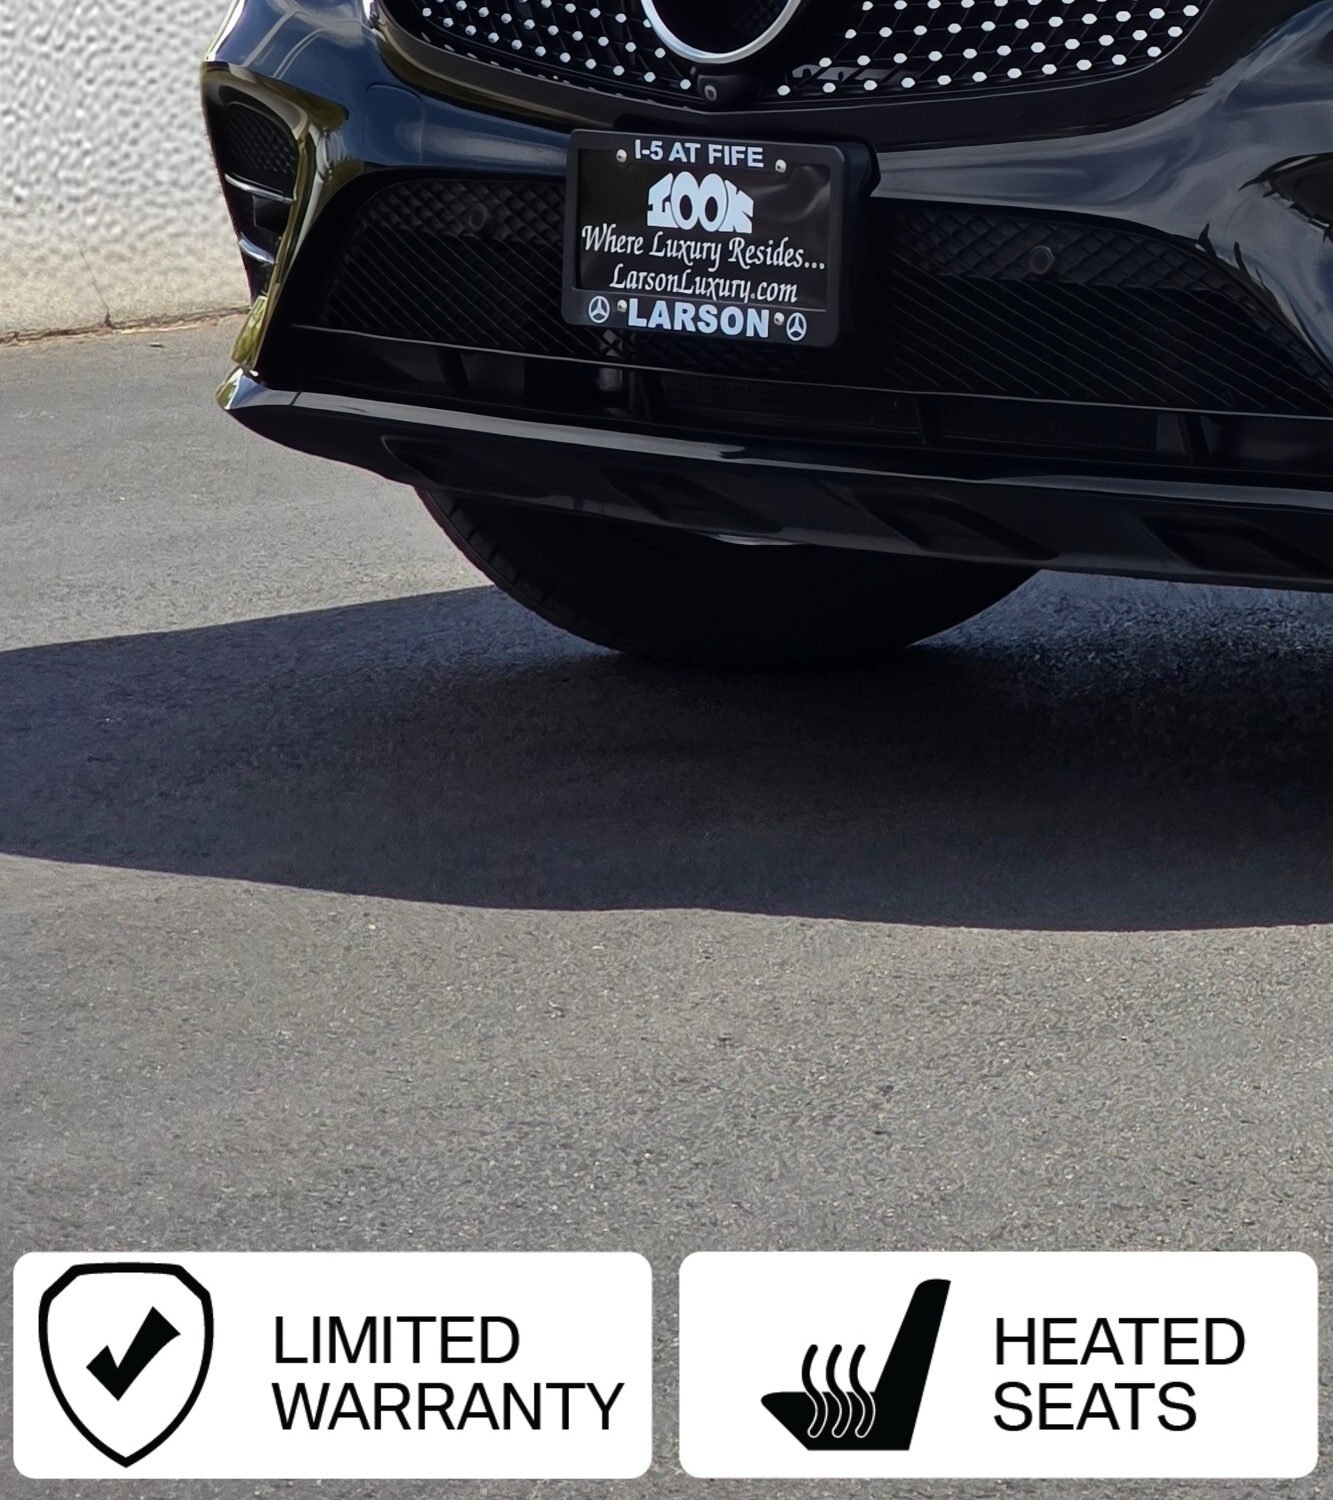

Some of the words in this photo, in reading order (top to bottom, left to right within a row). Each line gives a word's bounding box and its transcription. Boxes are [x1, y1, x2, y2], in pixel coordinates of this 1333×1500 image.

[634, 139, 664, 161] I-5
[668, 142, 701, 163] AT
[708, 144, 764, 168] FIFE
[581, 223, 644, 255] Where
[649, 231, 722, 272] Luxury
[728, 236, 825, 270] Resides...
[609, 263, 798, 303] LarsonLuxury.com
[627, 298, 769, 338] LARSON
